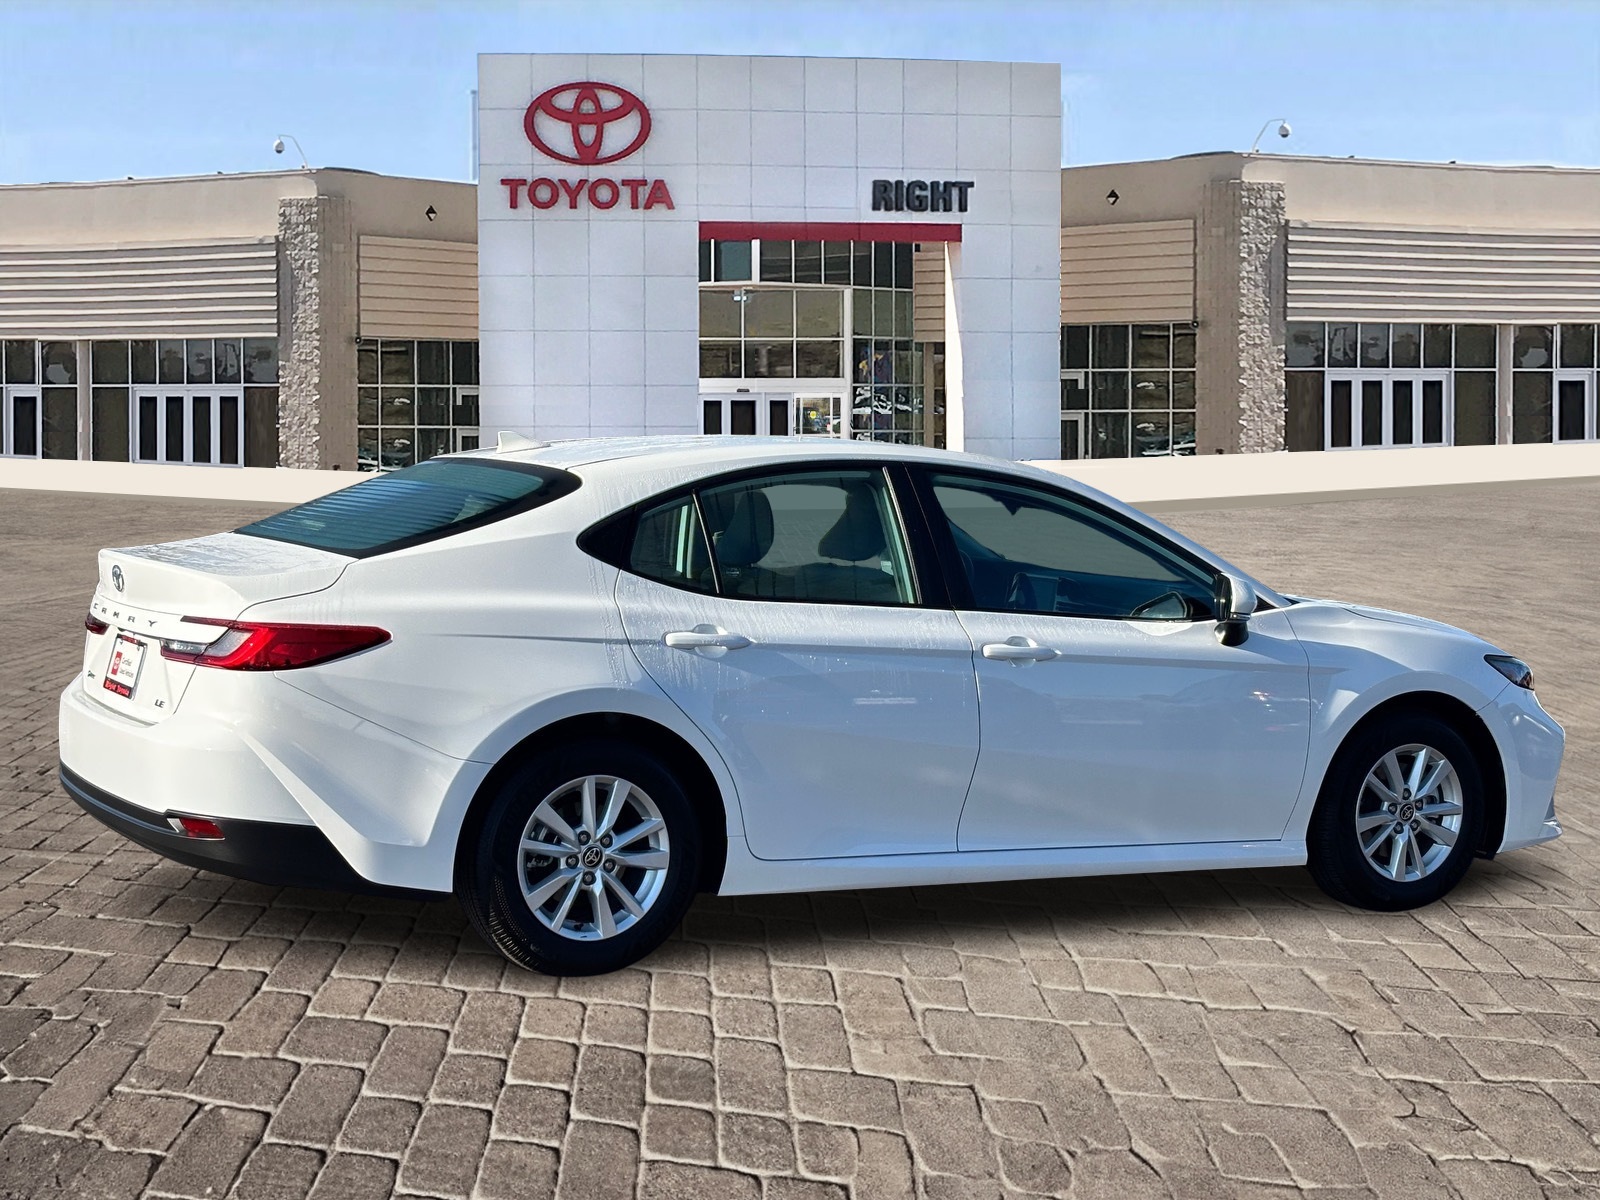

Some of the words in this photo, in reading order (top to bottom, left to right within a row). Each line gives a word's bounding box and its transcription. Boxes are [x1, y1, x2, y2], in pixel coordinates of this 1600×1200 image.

[500, 178, 676, 210] TOYOTA
[872, 179, 975, 212] RIGHT
[93, 602, 157, 627] CAMRY
[154, 698, 165, 708] LE
